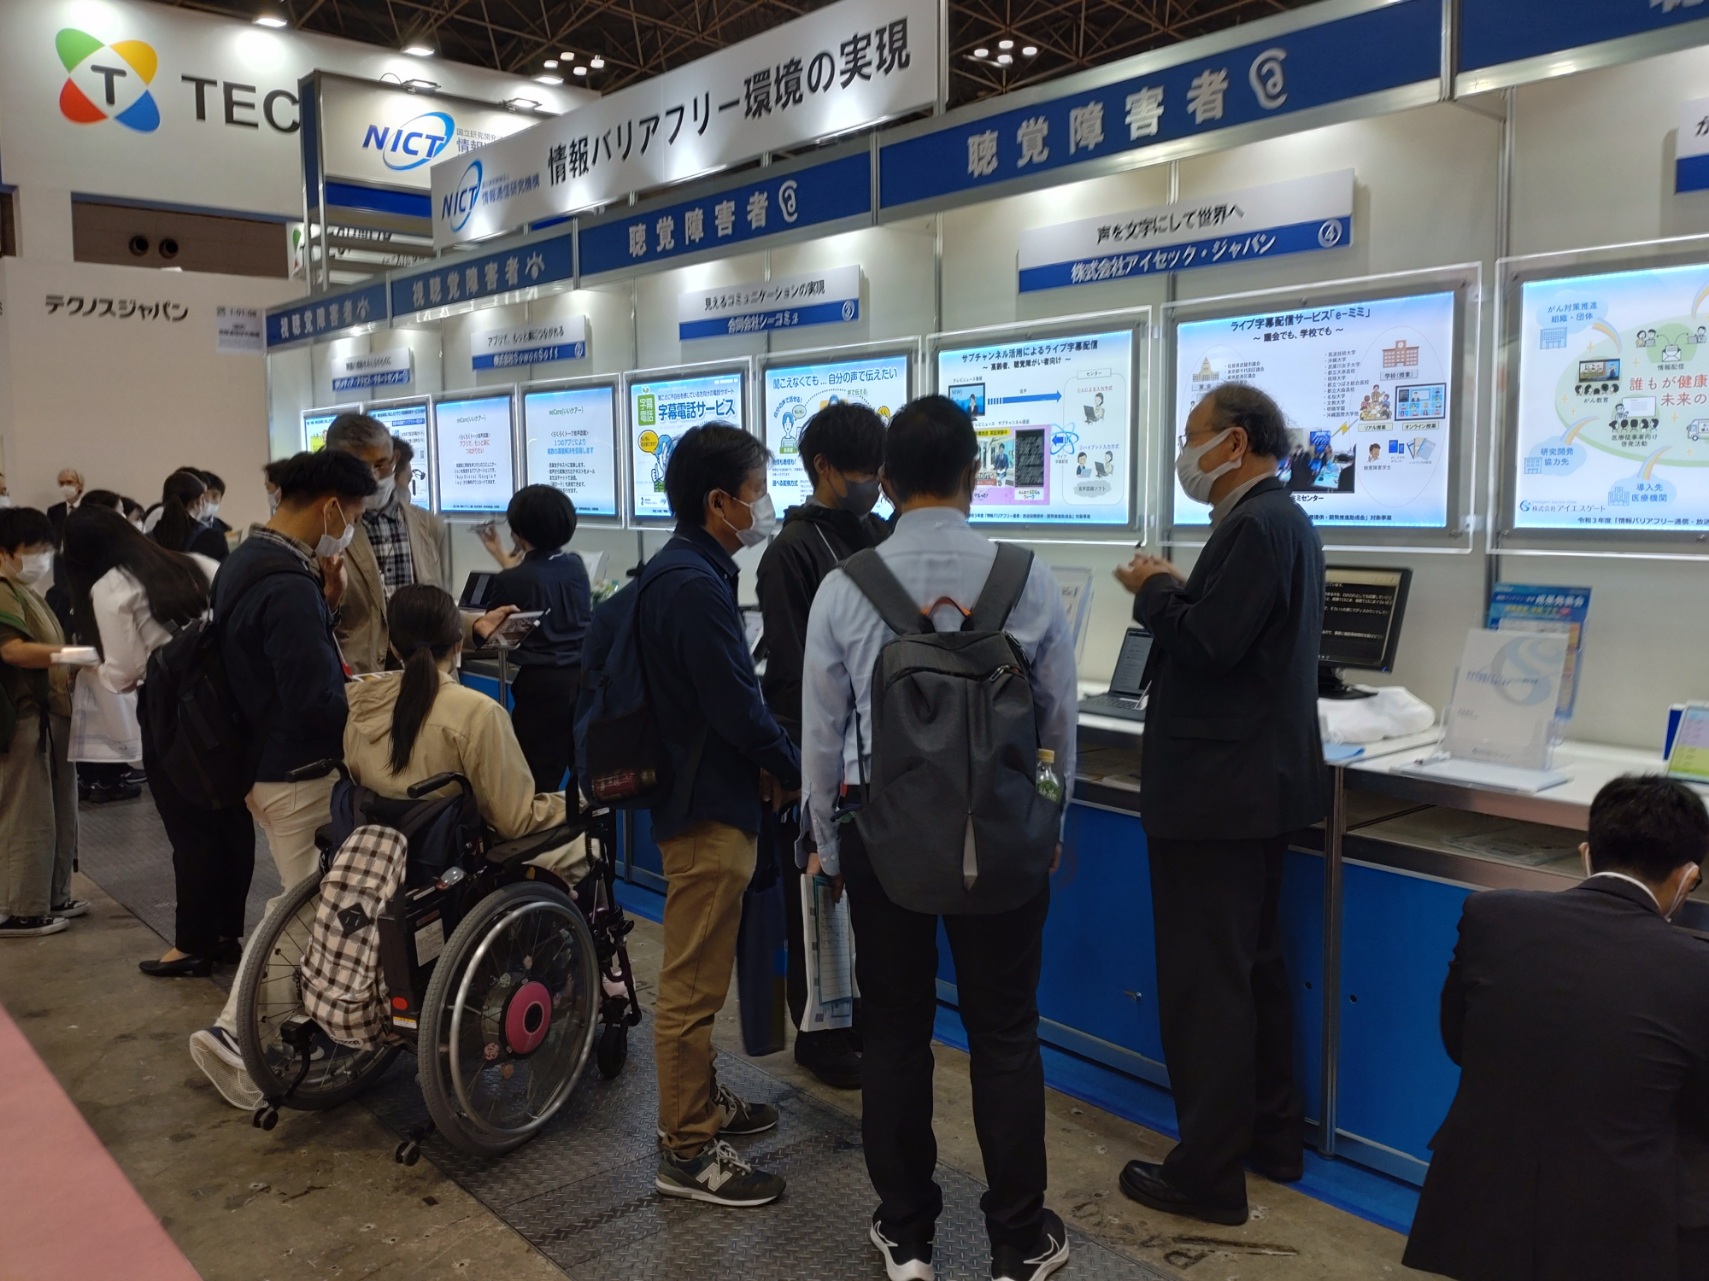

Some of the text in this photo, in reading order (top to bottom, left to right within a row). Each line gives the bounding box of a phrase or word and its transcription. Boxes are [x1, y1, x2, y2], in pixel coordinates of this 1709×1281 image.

[90, 64, 127, 106] T
[547, 17, 911, 186] 情報バリアフリー環境の実現
[966, 67, 1229, 178] 聴覚障害者
[362, 124, 446, 159] NICT
[441, 186, 478, 220] NICT
[628, 191, 769, 258] 聴覚障害者
[1097, 203, 1245, 245] 声を文字にして世界へ
[1070, 232, 1277, 284] 株式会社アイセック・ジャパン
[412, 256, 520, 308] 視聴覚障害者
[705, 279, 825, 312] 見えるコミュニケーションの実現
[45, 294, 189, 322] テクノスジャパン
[1548, 302, 1597, 313] がん対策推進
[1551, 313, 1593, 323] 組織・団体
[962, 340, 1098, 363] サブチャンネル活用によるライブ字幕配信
[1629, 373, 1708, 391] 誰もが健康
[658, 398, 735, 421] 字幕電話サービス
[1661, 392, 1707, 407] 未来の
